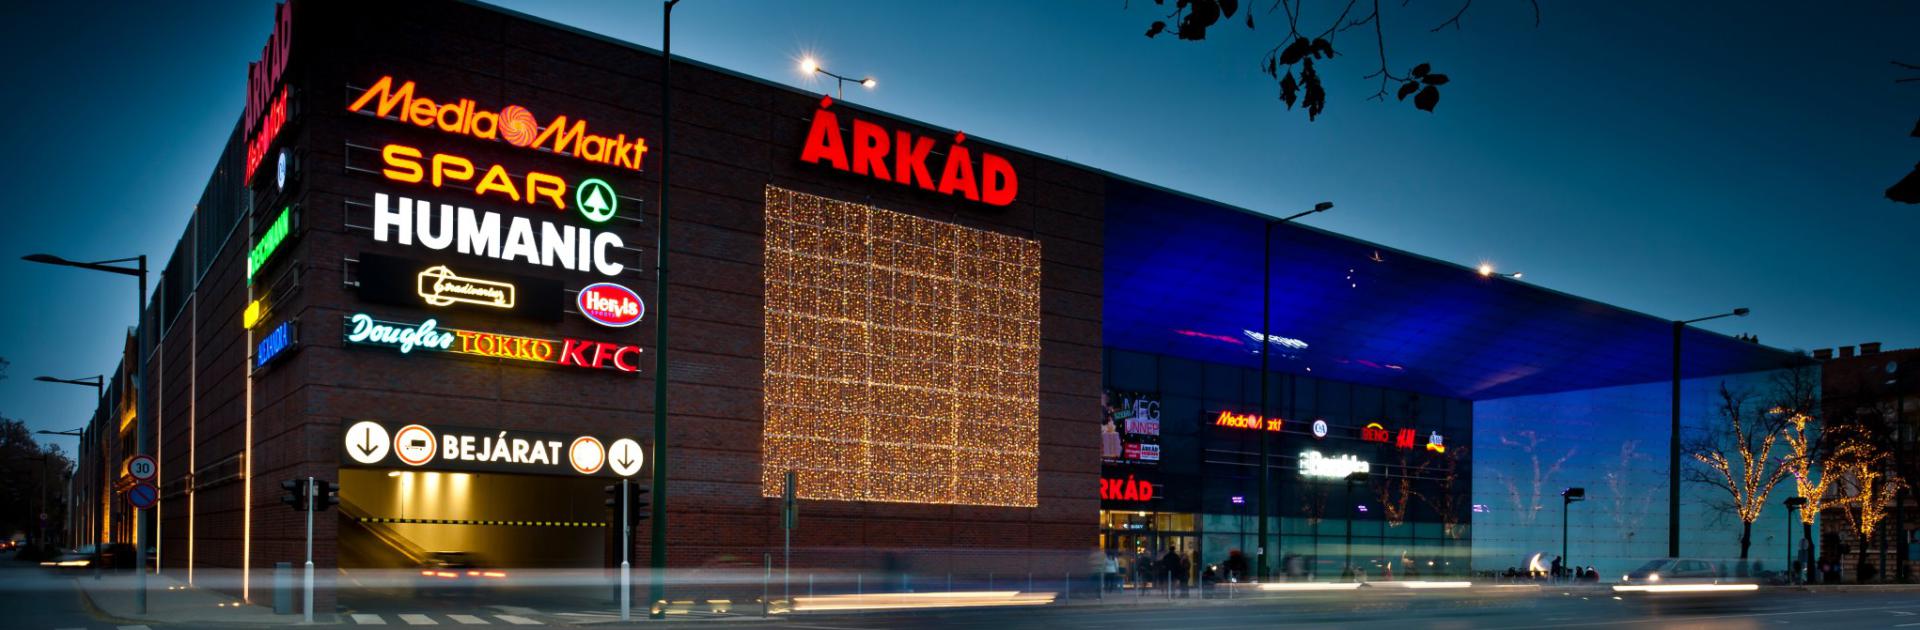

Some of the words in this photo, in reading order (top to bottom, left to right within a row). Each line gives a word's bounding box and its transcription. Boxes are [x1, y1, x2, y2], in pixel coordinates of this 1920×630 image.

[347, 75, 500, 141] Media
[530, 114, 648, 171] Markt
[801, 94, 1018, 207] ÁRKÁD
[382, 143, 567, 210] SPAR
[373, 192, 625, 277] HUMANIC
[586, 290, 638, 318] Hervis
[349, 313, 455, 354] Douglas
[557, 337, 641, 372] KFC
[442, 430, 563, 465] BEJÁRAT
[136, 462, 150, 474] 30
[1100, 474, 1153, 502] RKÁD
